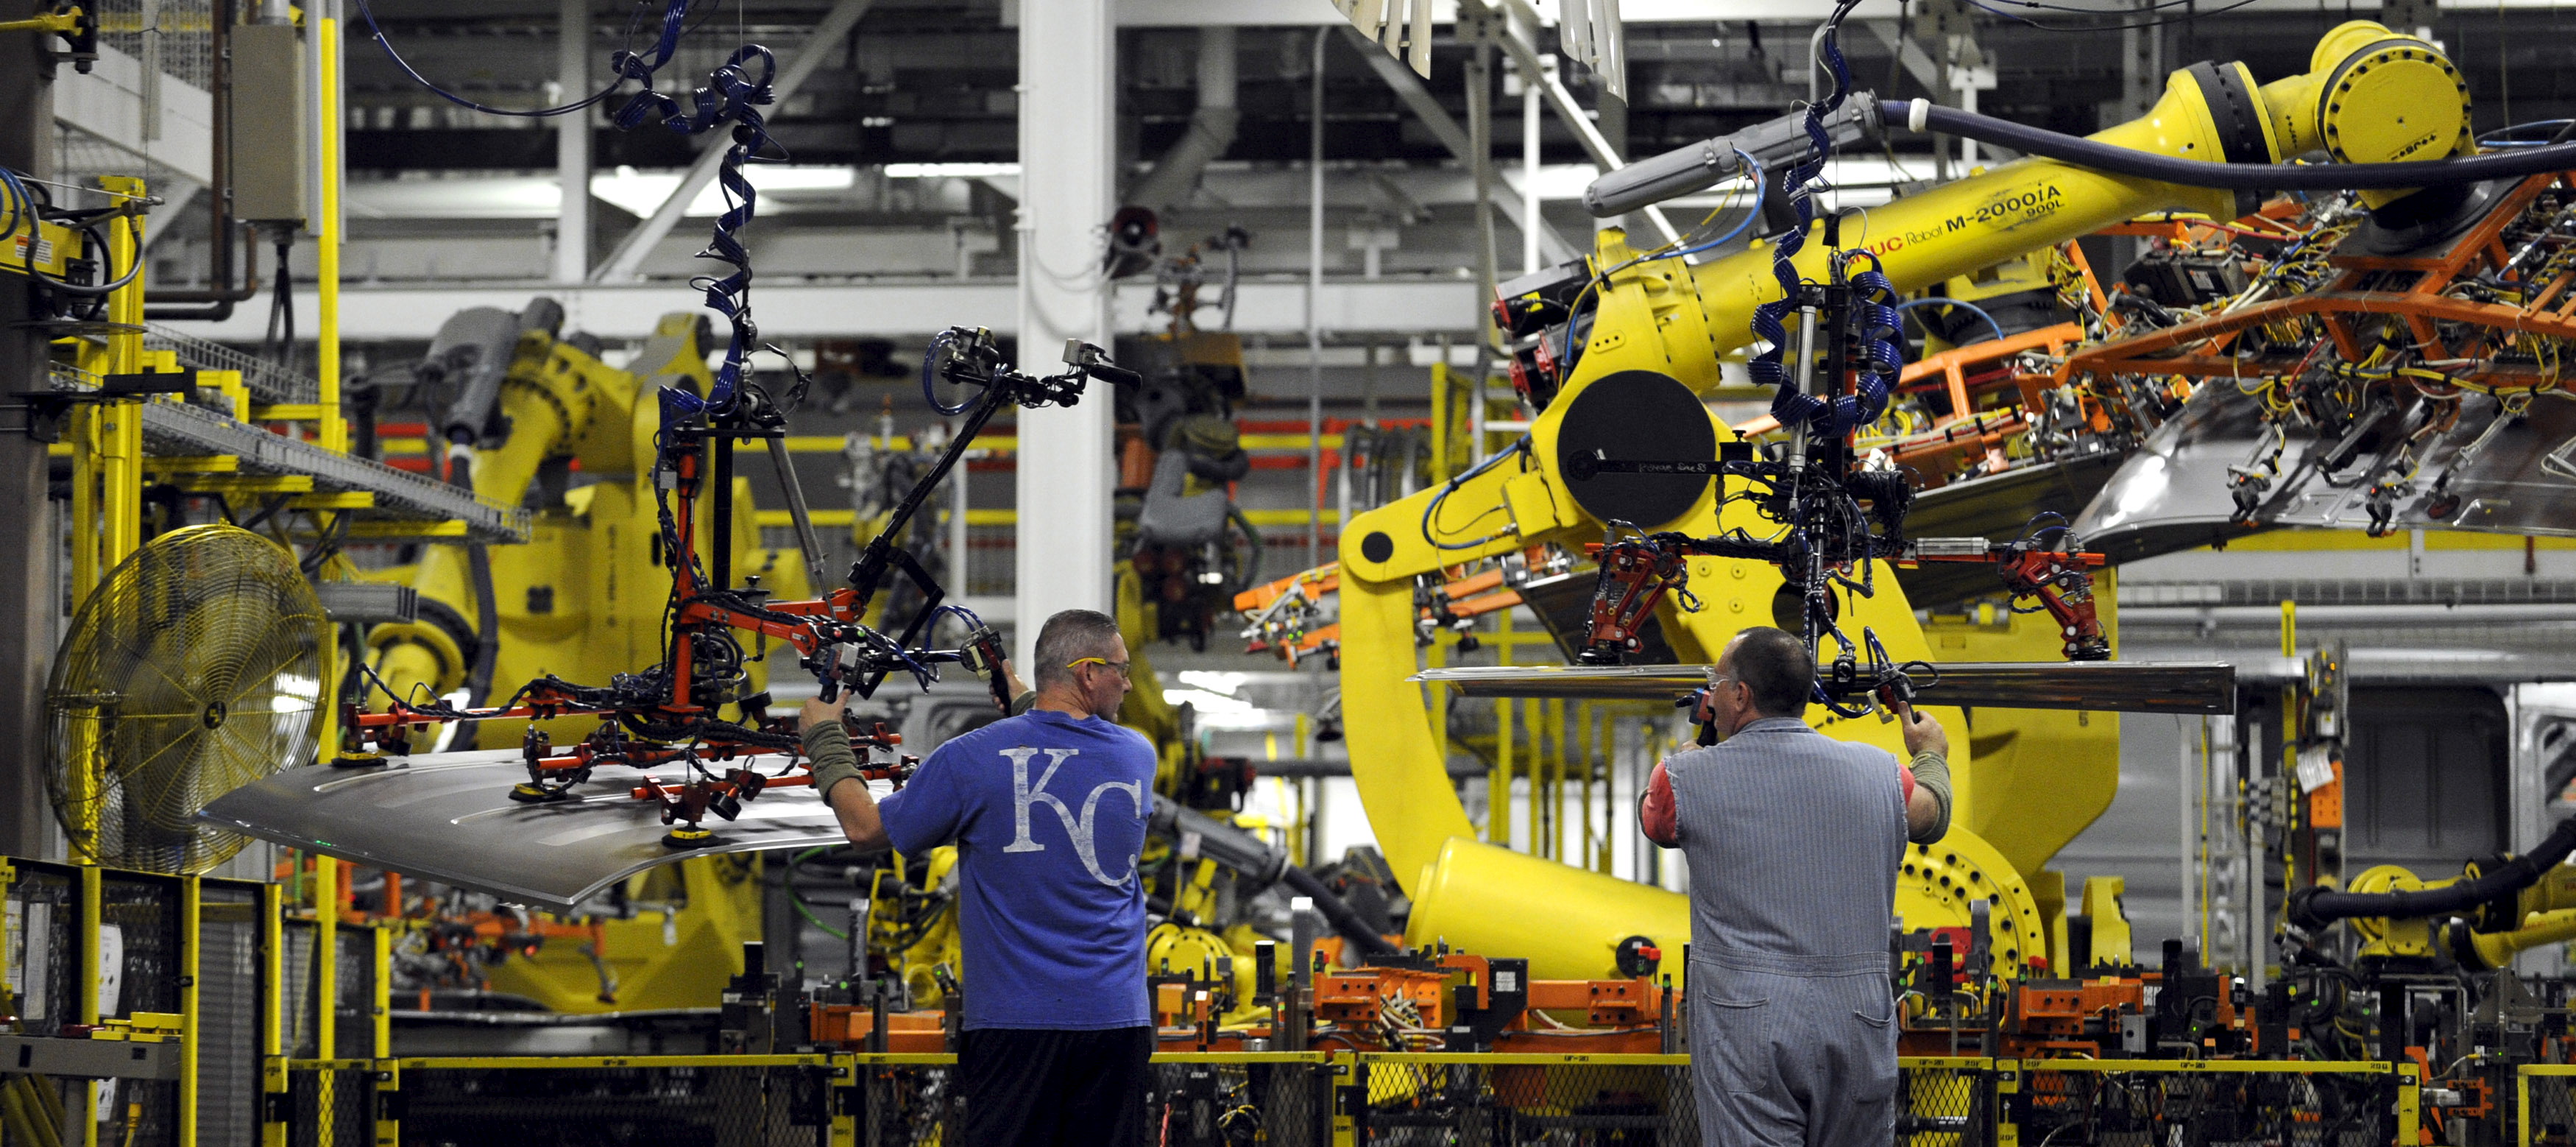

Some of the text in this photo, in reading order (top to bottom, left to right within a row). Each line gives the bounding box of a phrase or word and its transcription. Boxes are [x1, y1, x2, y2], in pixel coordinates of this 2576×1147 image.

[1829, 183, 2061, 266] NUC Robot M-2000iA
[2026, 200, 2065, 218] 900L
[999, 748, 1141, 886] KC
